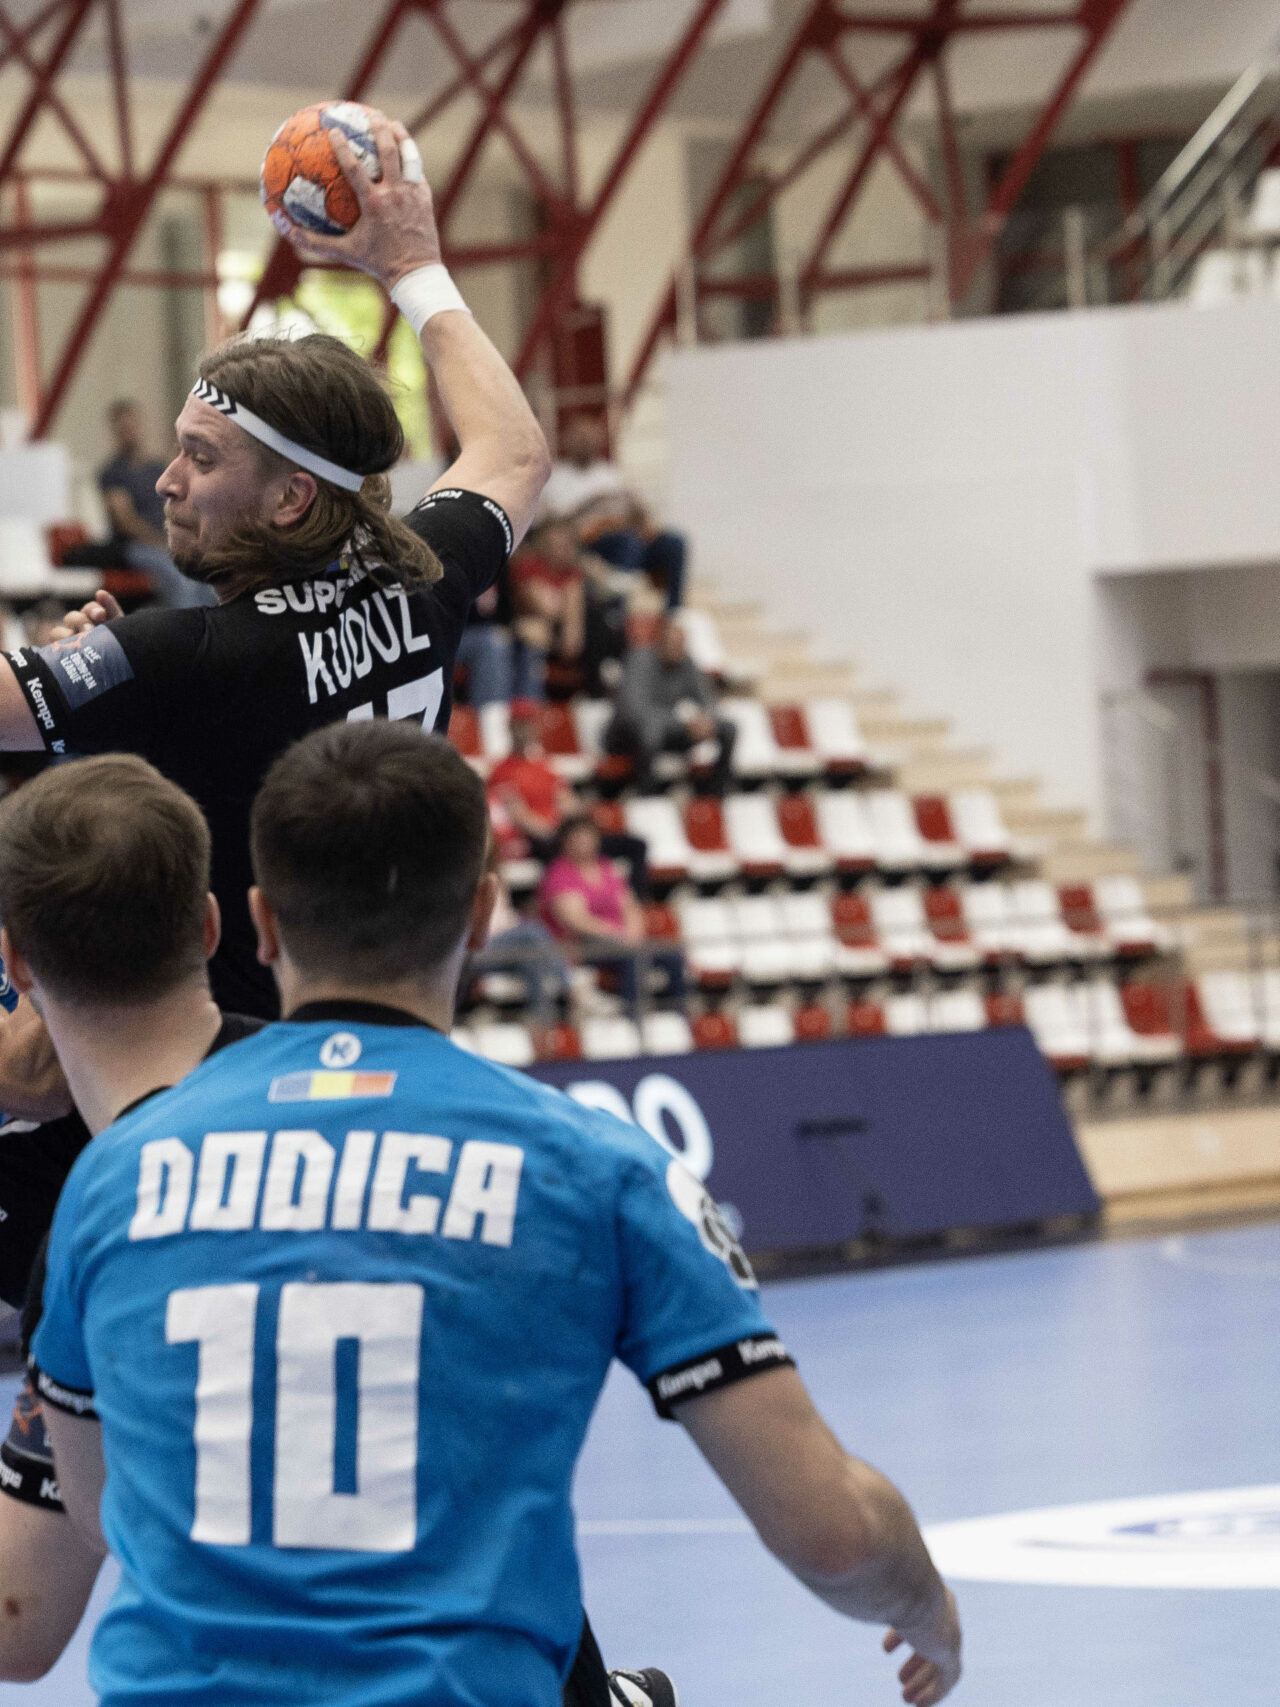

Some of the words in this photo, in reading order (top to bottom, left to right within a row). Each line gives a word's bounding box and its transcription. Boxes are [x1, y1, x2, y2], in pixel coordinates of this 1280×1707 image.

[27, 676, 56, 731] Kempa
[297, 582, 431, 704] KUDUZ
[128, 1129, 525, 1249] DODICA
[164, 1281, 425, 1552] 10
